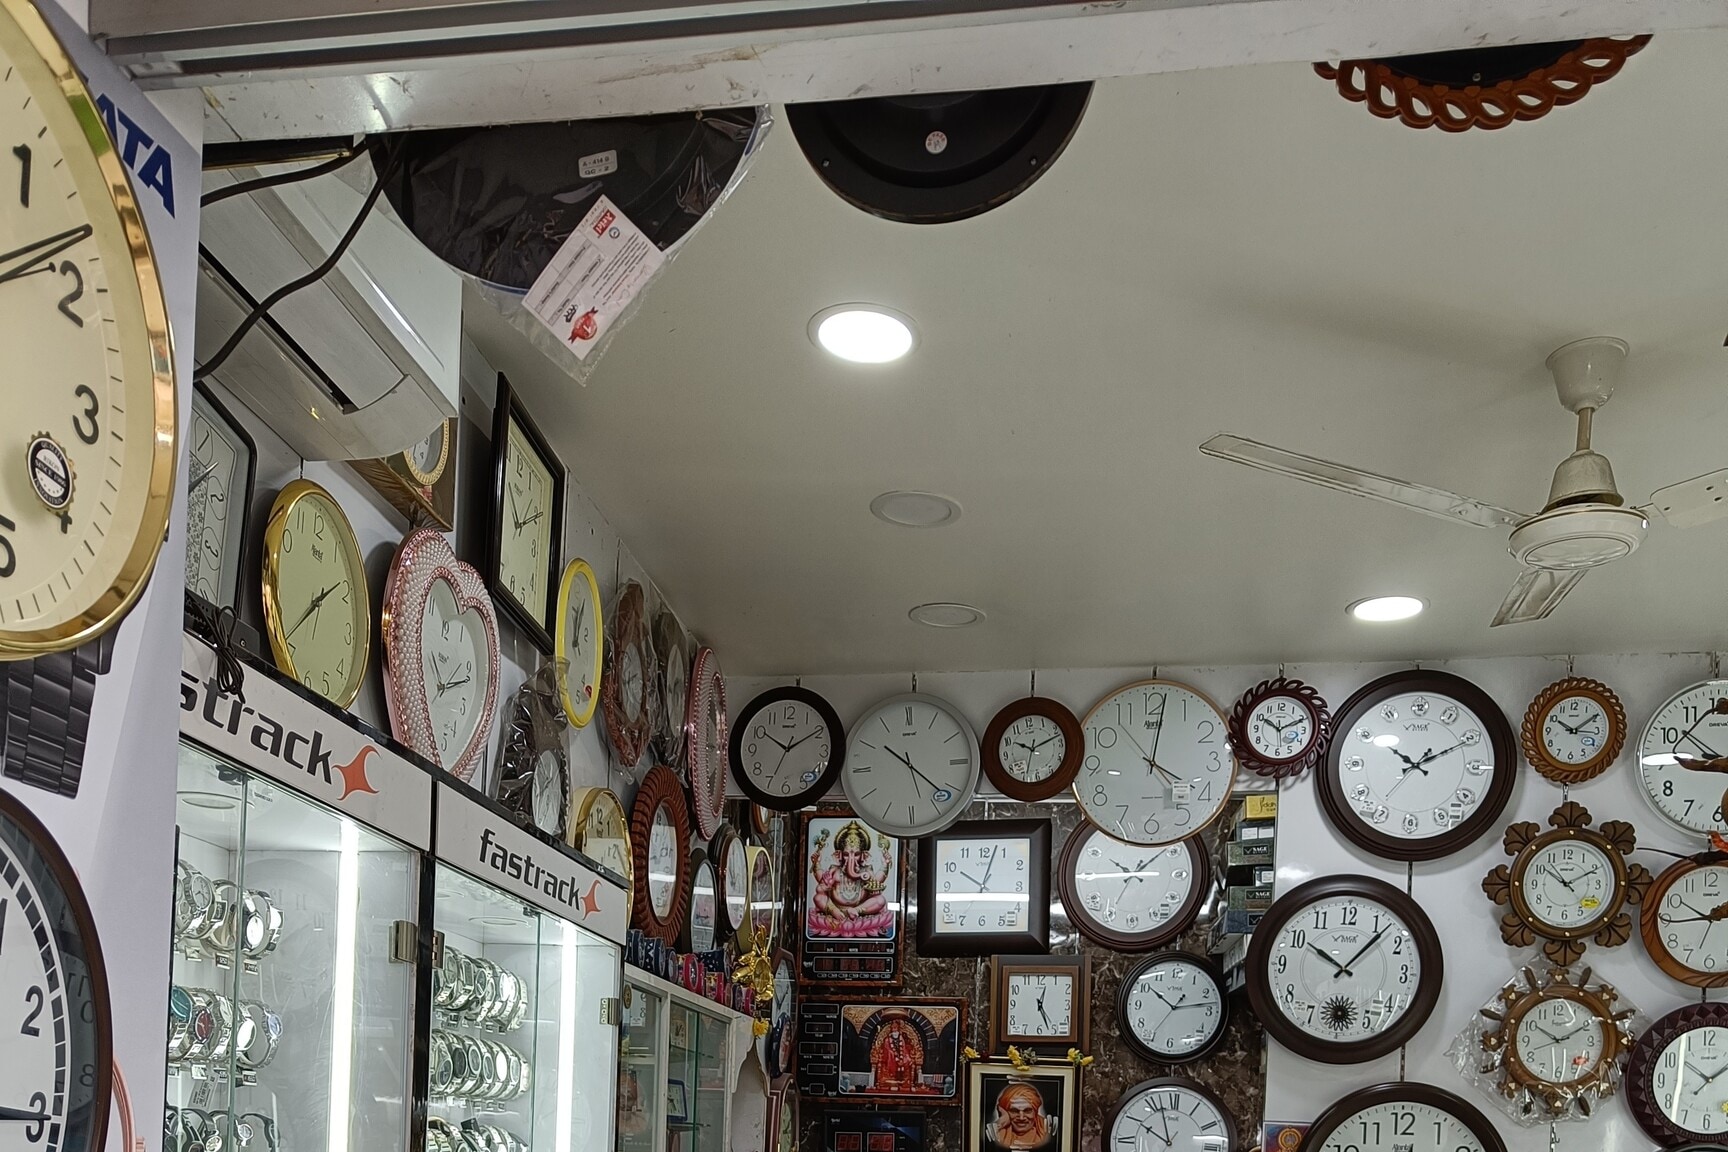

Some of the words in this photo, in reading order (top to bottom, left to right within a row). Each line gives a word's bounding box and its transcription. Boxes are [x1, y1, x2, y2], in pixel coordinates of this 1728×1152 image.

[12, 143, 32, 208] 1
[57, 259, 85, 329] 2
[71, 383, 100, 444] 3
[312, 511, 325, 541] 12
[333, 541, 339, 562] 1
[341, 580, 350, 603] 2
[344, 622, 353, 645] 3
[321, 672, 330, 695] 5
[1143, 692, 1164, 715] 12
[1182, 699, 1187, 722] 1
[767, 711, 777, 725] 11
[783, 706, 795, 720] 12
[805, 711, 809, 725] 1
[1116, 703, 1133, 725] 11
[1683, 706, 1698, 723] 11
[753, 726, 766, 739] 10
[814, 725, 824, 739] 2
[1092, 727, 1117, 749] 10
[1197, 720, 1214, 744] 2
[1661, 727, 1678, 744] 10
[748, 743, 757, 757] 9
[819, 744, 829, 758] 3
[752, 762, 762, 776] 8
[1084, 755, 1100, 777] 9
[1206, 751, 1221, 772] 3
[1092, 785, 1108, 807] 8
[1197, 781, 1212, 803] 4
[1663, 781, 1674, 797] 8
[1115, 804, 1129, 825] 7
[1174, 803, 1190, 826] 5
[1684, 799, 1694, 816] 7
[1144, 812, 1160, 834] 6
[960, 847, 969, 858] 11
[978, 847, 990, 858] 12
[1001, 848, 1007, 858] 1
[1562, 849, 1573, 860] 12
[479, 827, 580, 911] fastrack
[944, 862, 957, 873] 10
[1016, 860, 1024, 870] 2
[1535, 864, 1545, 875] 10
[1015, 881, 1023, 892] 3
[1531, 879, 1538, 890] 9
[1685, 878, 1694, 892] 11
[1704, 872, 1718, 888] 12
[1015, 902, 1022, 913] 4
[1666, 893, 1682, 908] 10
[997, 915, 1005, 926] 5
[1313, 910, 1328, 929] 11
[1341, 906, 1357, 925] 12
[1372, 914, 1379, 933] 1
[1290, 930, 1305, 948] 10
[1392, 935, 1402, 955] 2
[1667, 933, 1678, 948] 8
[1278, 954, 1287, 973] 9
[1683, 948, 1694, 963] 7
[1703, 954, 1715, 969] 6
[1036, 975, 1046, 985] 12
[1400, 964, 1408, 984] 3
[1011, 984, 1020, 995] 10
[1140, 983, 1150, 993] 10
[1202, 988, 1210, 999] 2
[1285, 983, 1295, 1003] 8
[20, 984, 43, 1036] 2
[1384, 993, 1393, 1013] 4
[1166, 1038, 1174, 1048] 6
[1702, 1030, 1715, 1046] 12
[1664, 1052, 1676, 1068] 10
[1657, 1073, 1665, 1089] 9
[1664, 1093, 1672, 1109] 8
[26, 1090, 49, 1143] 3
[1390, 1112, 1416, 1136] 12
[1359, 1122, 1380, 1145] 11
[1433, 1122, 1441, 1145] 1
